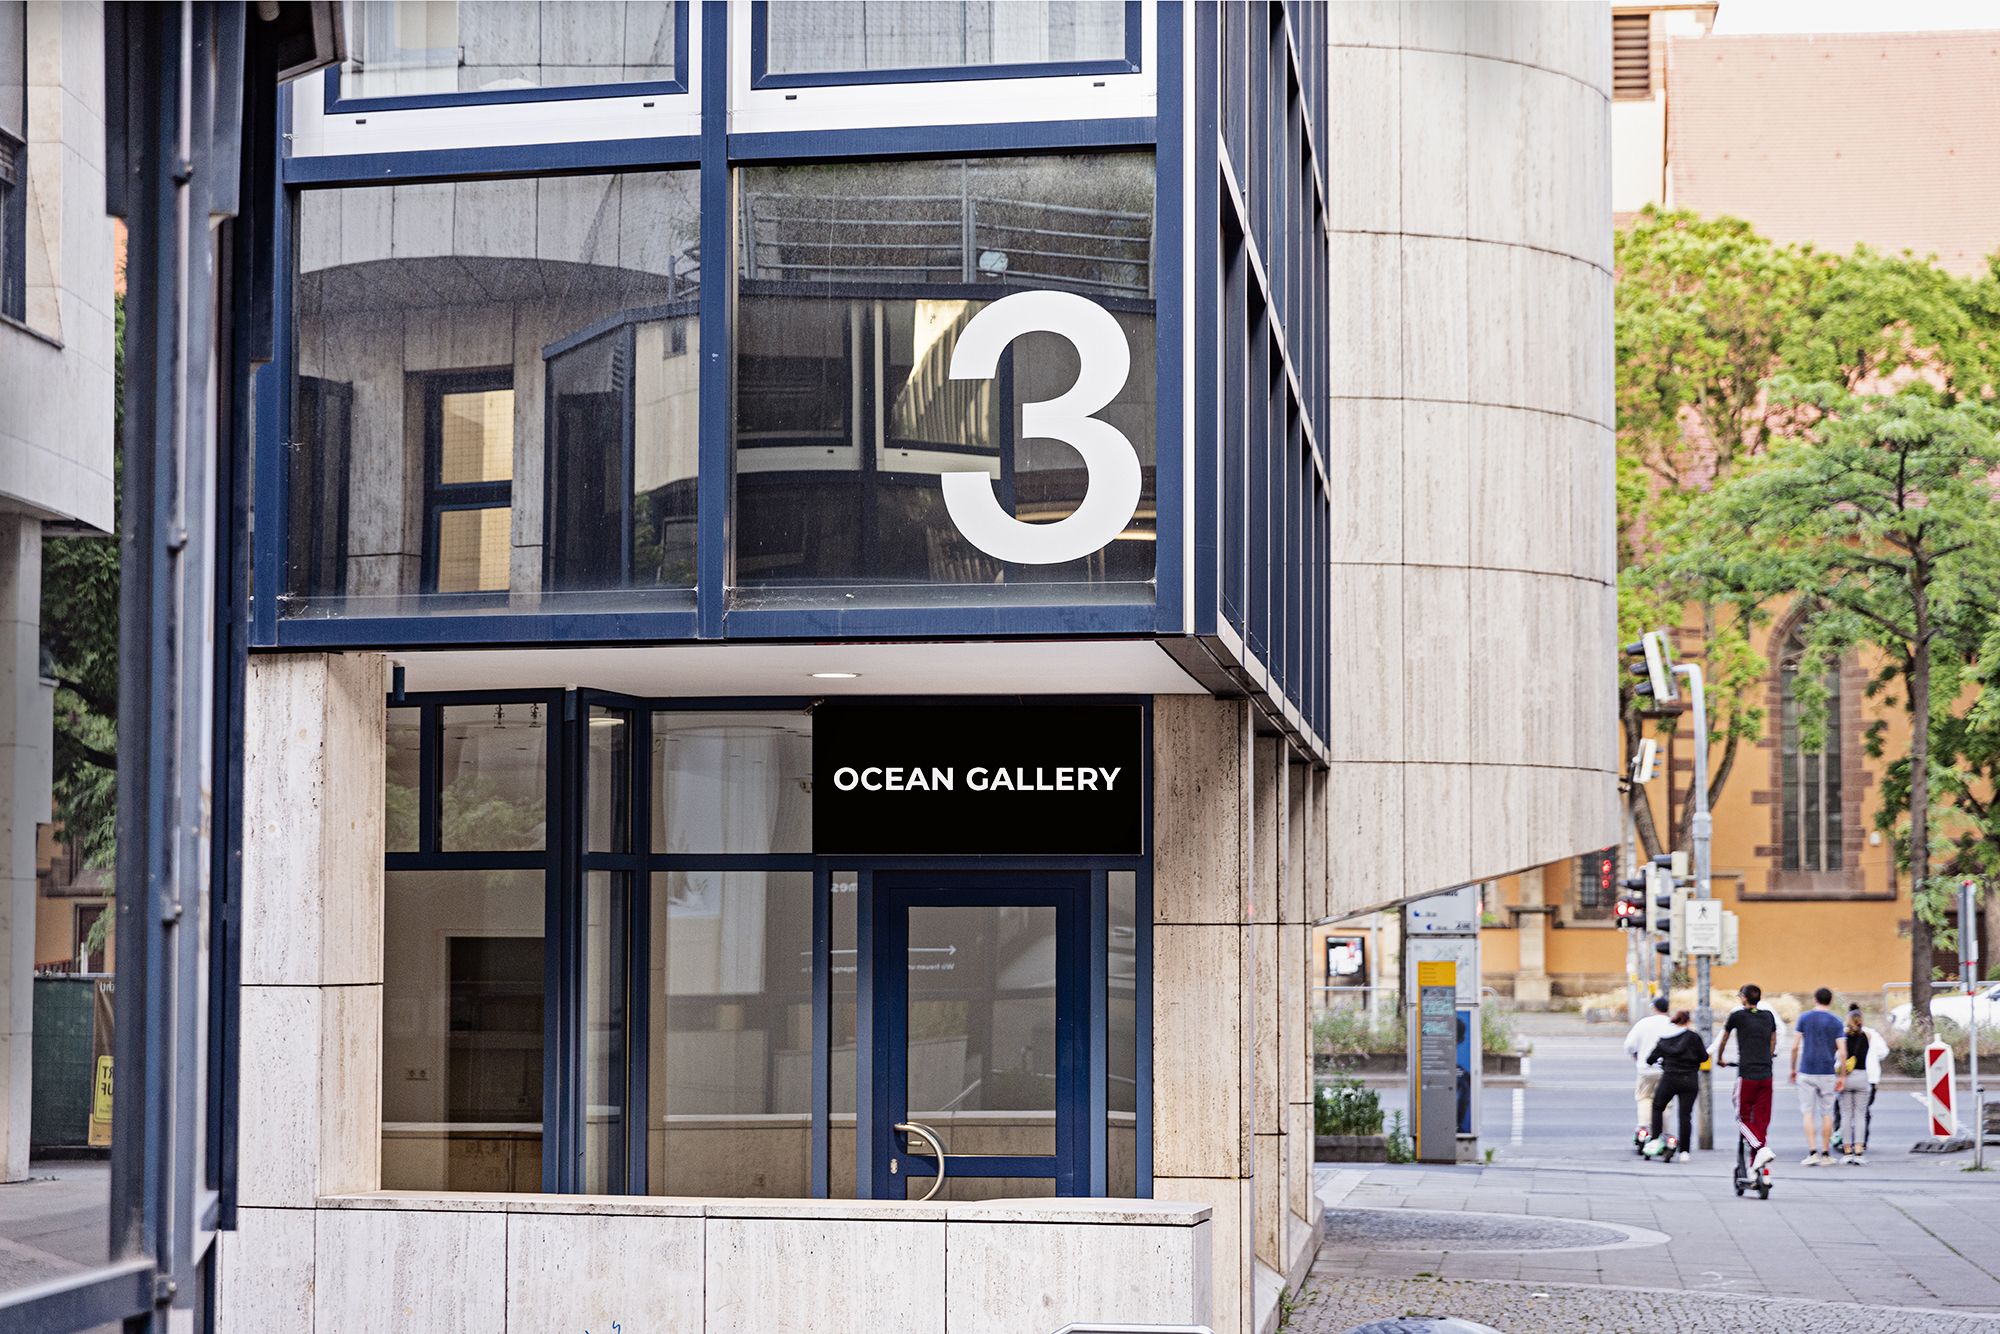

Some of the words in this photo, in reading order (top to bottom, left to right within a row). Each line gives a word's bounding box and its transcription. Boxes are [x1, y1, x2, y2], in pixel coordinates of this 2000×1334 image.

[941, 291, 1142, 564] 3
[833, 766, 954, 791] OCEAN
[966, 766, 1121, 791] GALLERY
